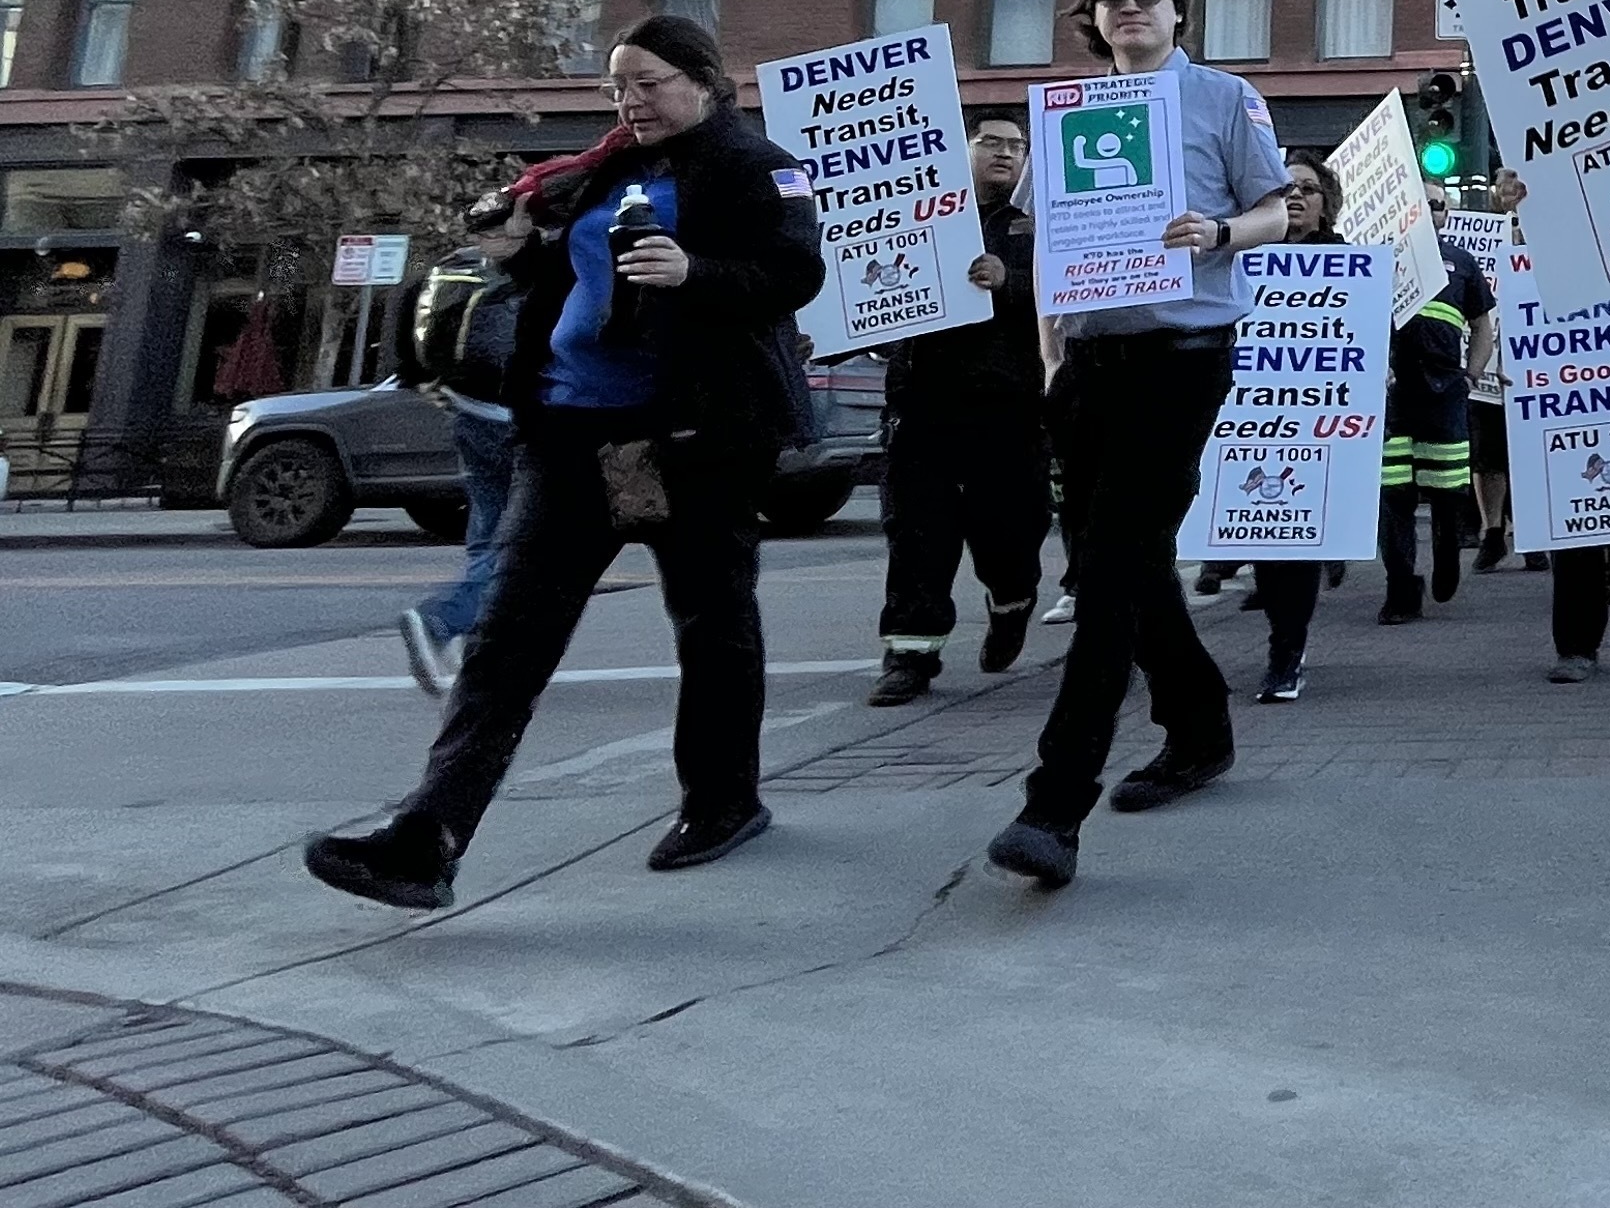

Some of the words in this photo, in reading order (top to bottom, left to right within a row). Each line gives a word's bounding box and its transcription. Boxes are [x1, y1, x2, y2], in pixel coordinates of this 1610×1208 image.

[780, 37, 931, 93] DENVER
[812, 76, 915, 118] Needs
[1084, 76, 1156, 92] STRATEGIC
[801, 103, 930, 149] Transit,
[1329, 104, 1393, 174] DENVER
[799, 128, 948, 181] DENVER
[1345, 134, 1389, 189] Needs
[815, 164, 941, 213] Transit
[1051, 196, 1103, 209] Employee
[1105, 189, 1164, 203] Ownership
[1343, 163, 1409, 237] DENVER
[818, 208, 901, 242] eeds
[913, 188, 969, 222] US!
[1148, 201, 1166, 210] and
[1352, 190, 1409, 245] Transit
[1398, 199, 1423, 235] US!
[1088, 219, 1117, 230] highly
[1120, 215, 1150, 225] skilled
[1153, 213, 1170, 222] and
[1447, 215, 1505, 234] ITHOUT
[841, 242, 879, 262] ATU
[885, 229, 928, 252] 1001
[1065, 259, 1121, 277] RIGHT
[1125, 254, 1165, 270] IDEA
[1242, 253, 1373, 278] ENVER
[855, 287, 931, 314] TRANSIT
[1052, 285, 1117, 305] WRONG
[1124, 277, 1184, 296] TRACK
[851, 301, 939, 332] WORKERS
[1241, 316, 1354, 343] ransit,
[1233, 346, 1366, 372] ENVER
[1526, 369, 1549, 388] Is
[1235, 382, 1349, 407] ransit
[1213, 415, 1300, 439] eeds
[1313, 414, 1376, 439] US!
[1224, 447, 1267, 462] ATU
[1276, 447, 1323, 462] 1001
[1549, 429, 1599, 453] ATU
[1226, 508, 1312, 523] TRANSIT
[1217, 525, 1317, 540] WORKERS
